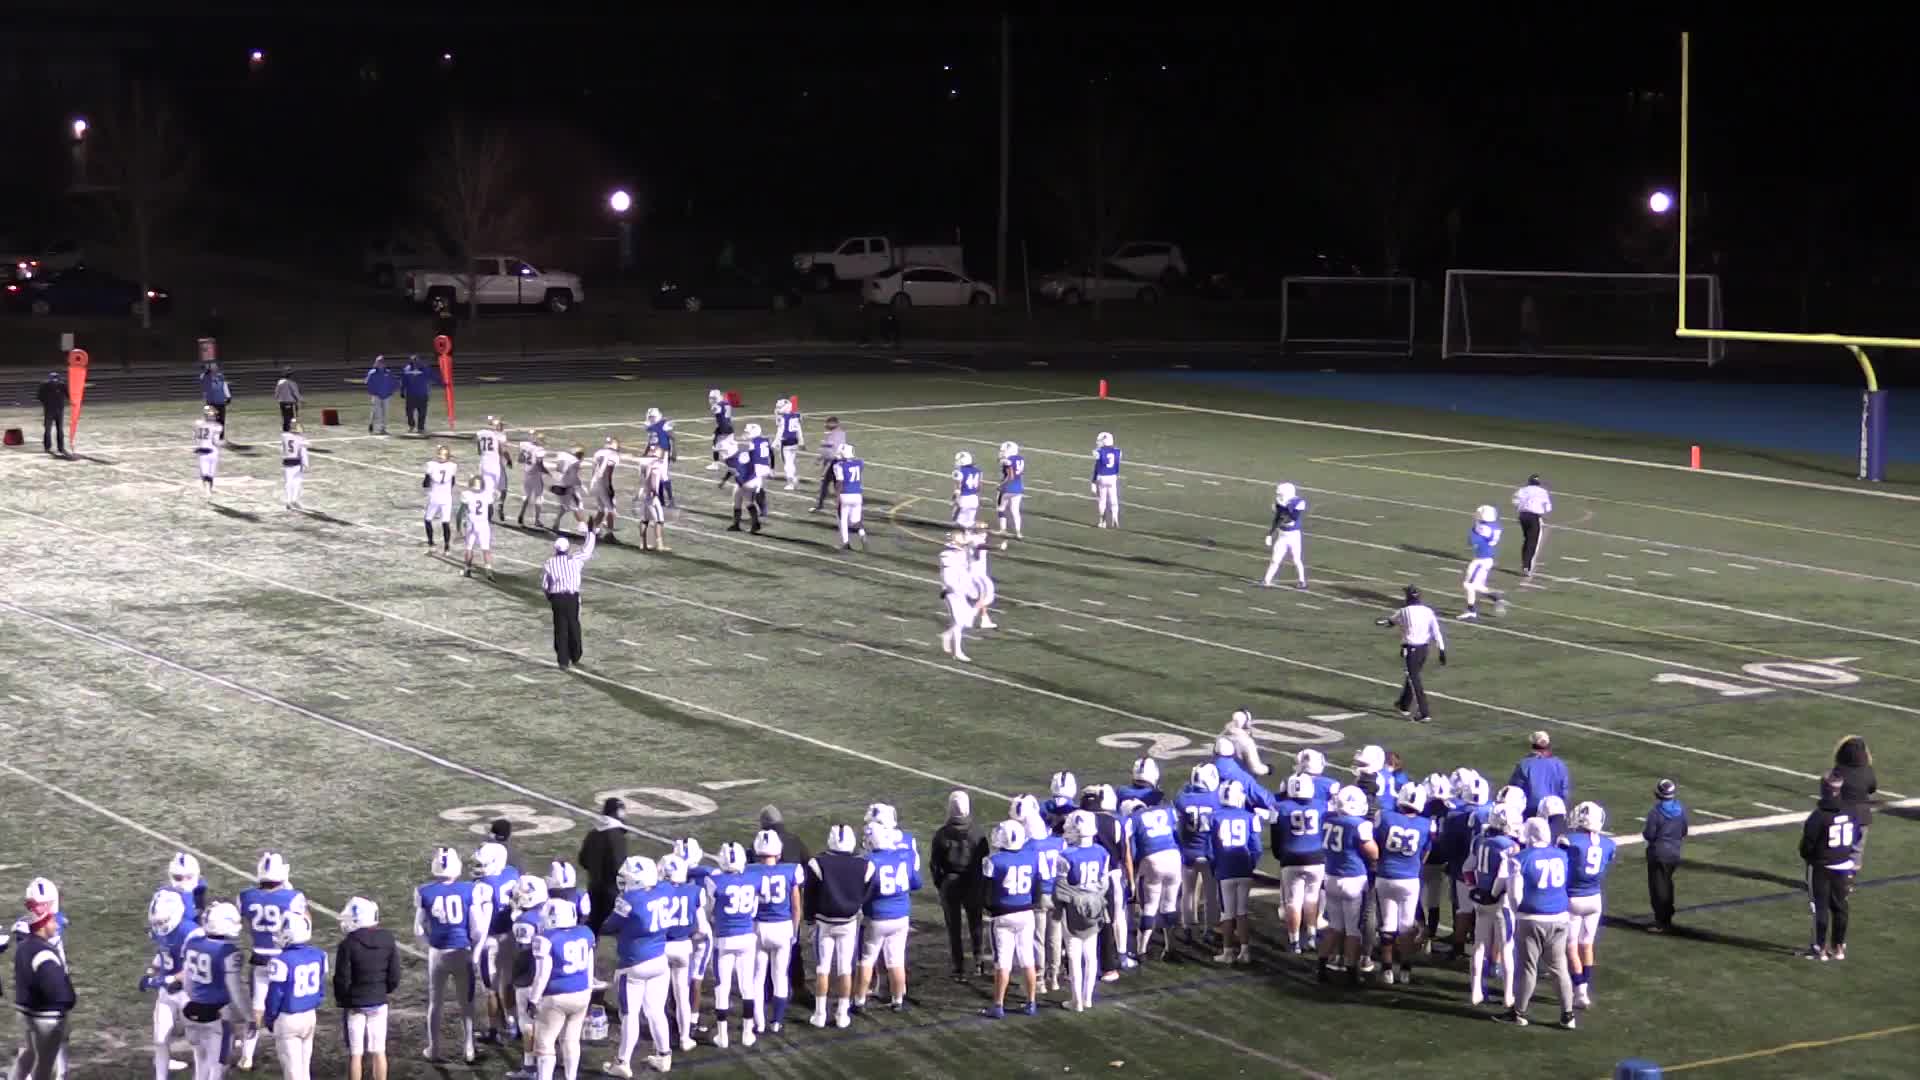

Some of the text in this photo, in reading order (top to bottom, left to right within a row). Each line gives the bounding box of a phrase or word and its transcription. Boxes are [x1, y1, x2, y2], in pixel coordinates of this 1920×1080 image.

[849, 467, 860, 482] 71
[1106, 453, 1115, 468] 3
[1220, 819, 1247, 847] 49
[1291, 809, 1319, 836] 93
[1322, 823, 1344, 853] 73
[1386, 825, 1420, 857] 63
[1535, 857, 1566, 889] 78
[1585, 846, 1602, 875] 9
[880, 861, 909, 895] 64
[1003, 864, 1032, 895] 46
[432, 894, 463, 924] 40
[724, 884, 754, 914] 38
[248, 903, 282, 932] 29
[563, 938, 588, 974] 90
[293, 962, 320, 997] 83
